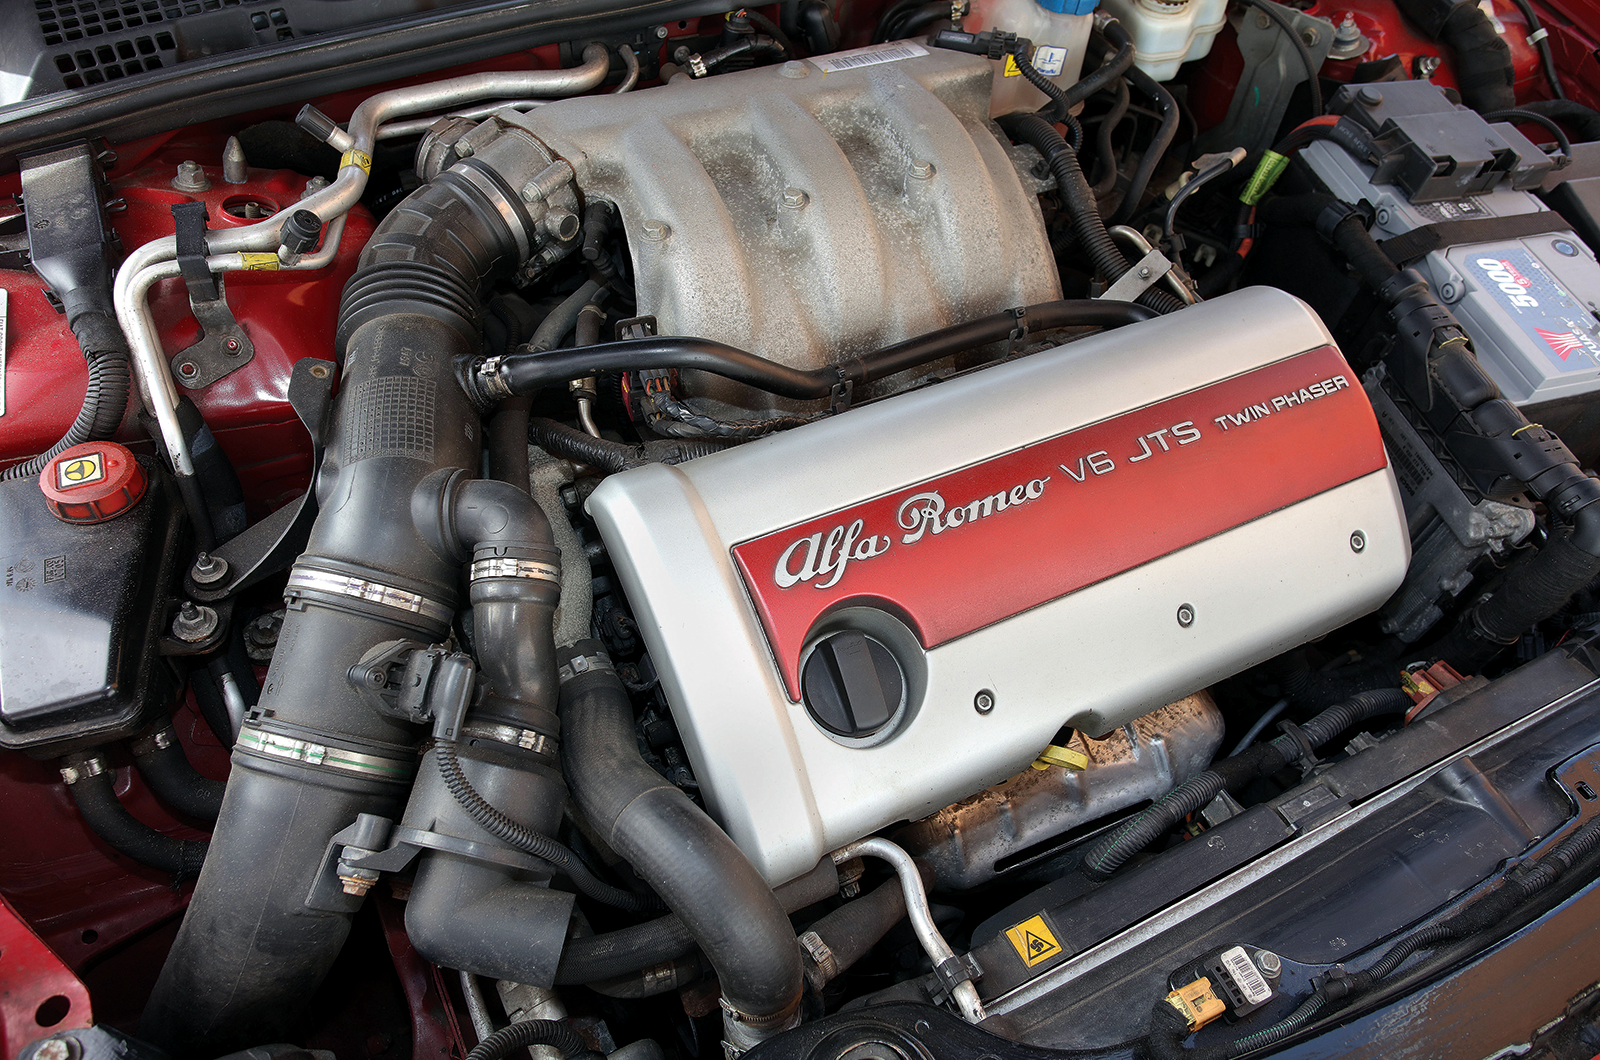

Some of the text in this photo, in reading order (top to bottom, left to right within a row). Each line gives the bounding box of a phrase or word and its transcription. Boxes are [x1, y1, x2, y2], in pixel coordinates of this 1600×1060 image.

[1476, 258, 1539, 308] 5000
[775, 374, 1350, 589] Alfa Romeo V6 JTS TWIN PHASER
[1399, 475, 1415, 497] BOSCH
